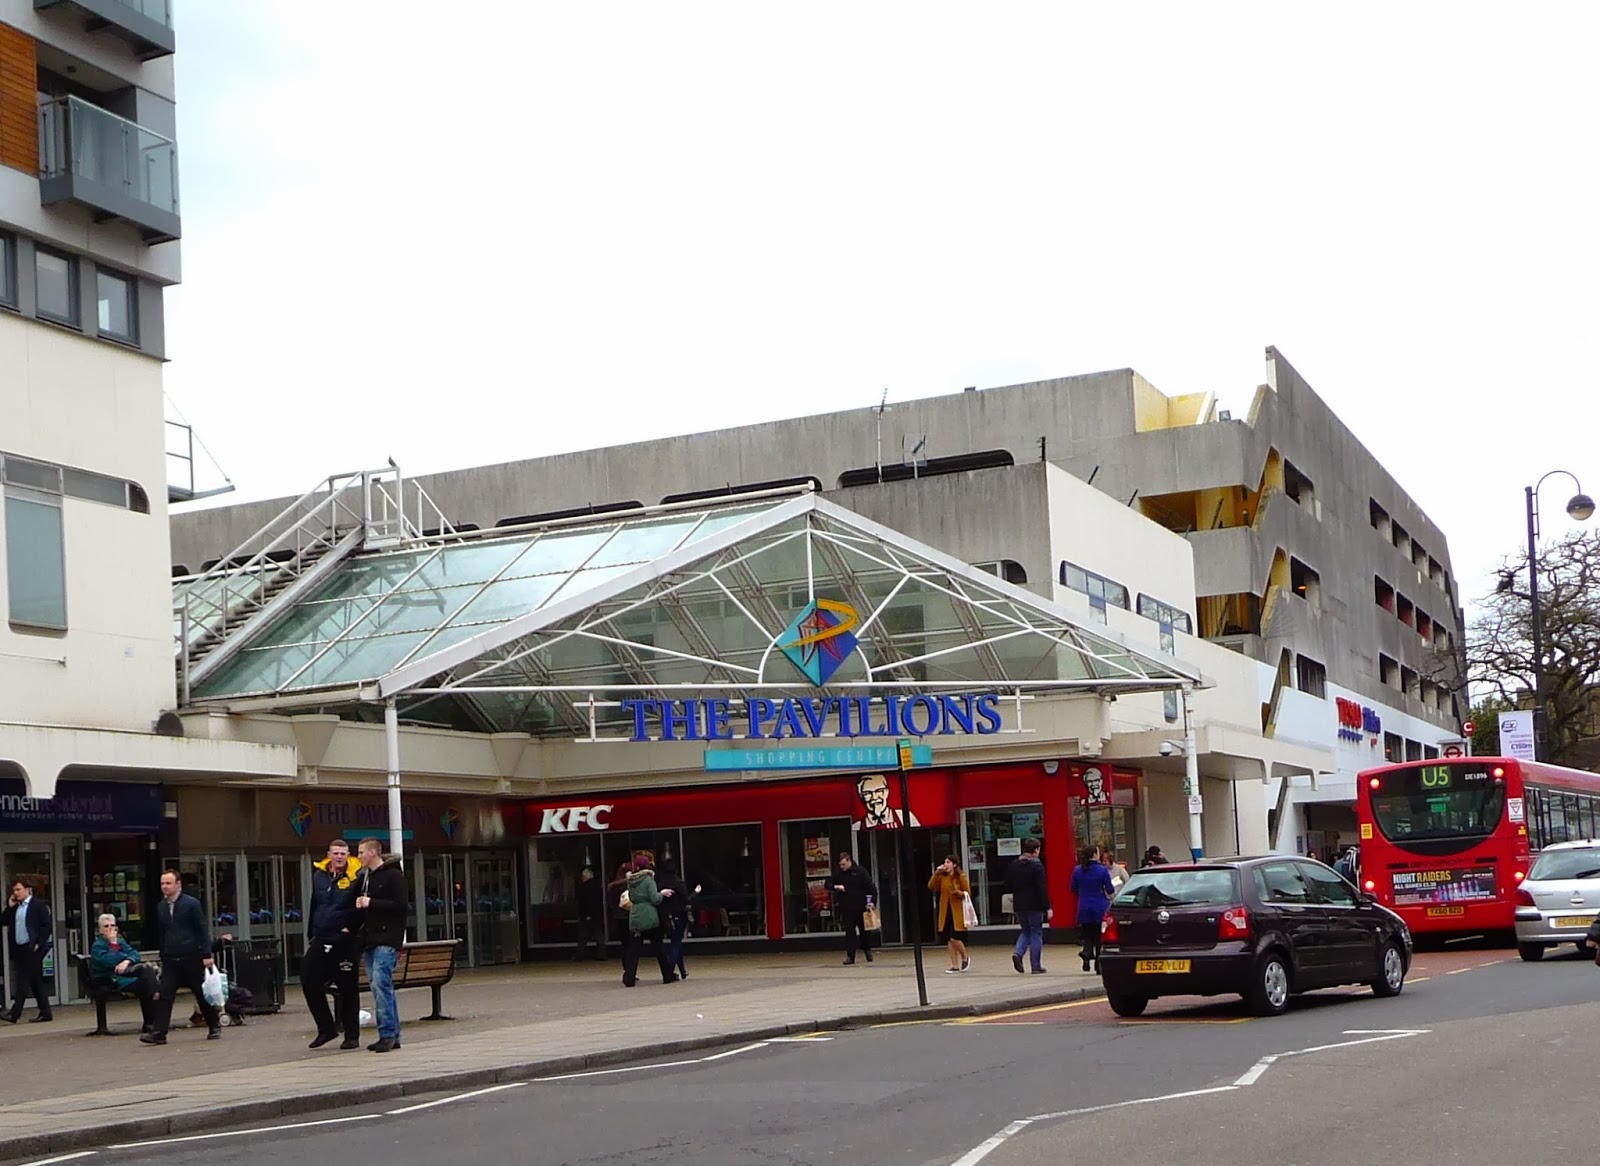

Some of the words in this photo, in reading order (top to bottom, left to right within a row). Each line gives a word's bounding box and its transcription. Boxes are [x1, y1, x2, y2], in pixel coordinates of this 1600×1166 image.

[622, 698, 733, 742] THE
[745, 693, 1002, 739] PAVILIONS
[1463, 721, 1473, 732] C
[745, 750, 825, 766] SHOPPING
[837, 749, 893, 764] CENTRE
[1422, 765, 1449, 787] U5
[3, 811, 55, 821] independent
[58, 811, 83, 821] estate
[87, 812, 114, 822] agents
[315, 802, 350, 825] THE
[356, 803, 434, 826] PAVIONS
[538, 804, 613, 834] KFC
[1393, 872, 1416, 884] NIGHT
[1416, 870, 1452, 883] RAIDERS
[1140, 961, 1164, 971] LS52
[1167, 960, 1186, 971] YLU
